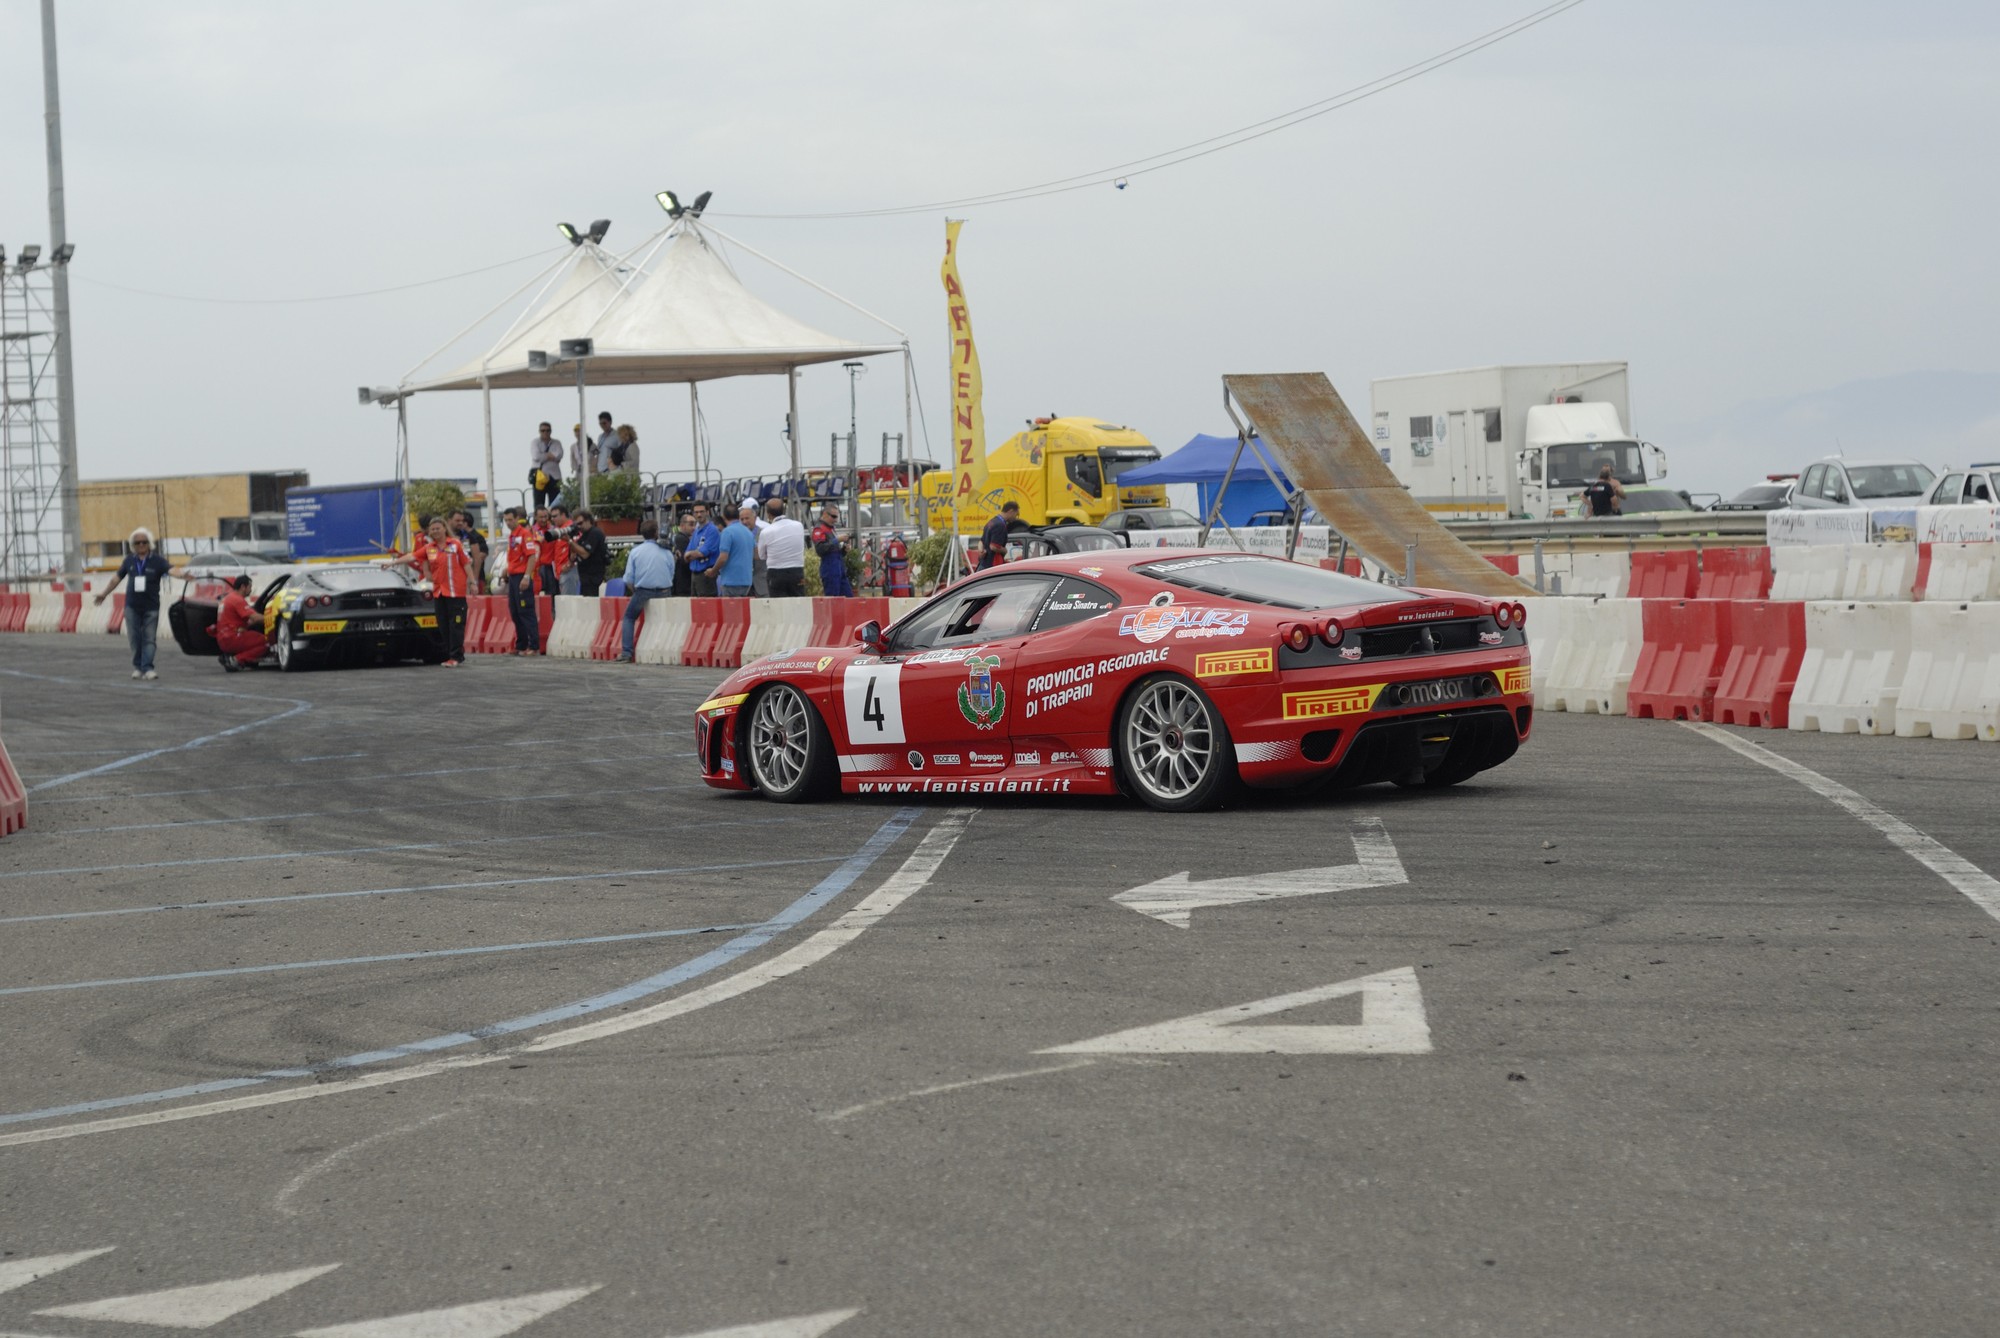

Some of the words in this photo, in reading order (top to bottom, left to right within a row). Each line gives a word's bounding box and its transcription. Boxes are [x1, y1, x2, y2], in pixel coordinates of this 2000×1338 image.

[364, 620, 395, 632] motor
[1026, 663, 1095, 696] PROVINCIA
[1098, 646, 1170, 675] REGIONALE
[1198, 651, 1270, 675] PIRELLI
[863, 676, 885, 731] 4
[1026, 700, 1038, 718] DI
[1041, 683, 1093, 711] TRAPANI
[1286, 689, 1370, 716] PIRELLI
[1410, 679, 1464, 703] motor
[858, 778, 1071, 793] www.leoisolani.it
